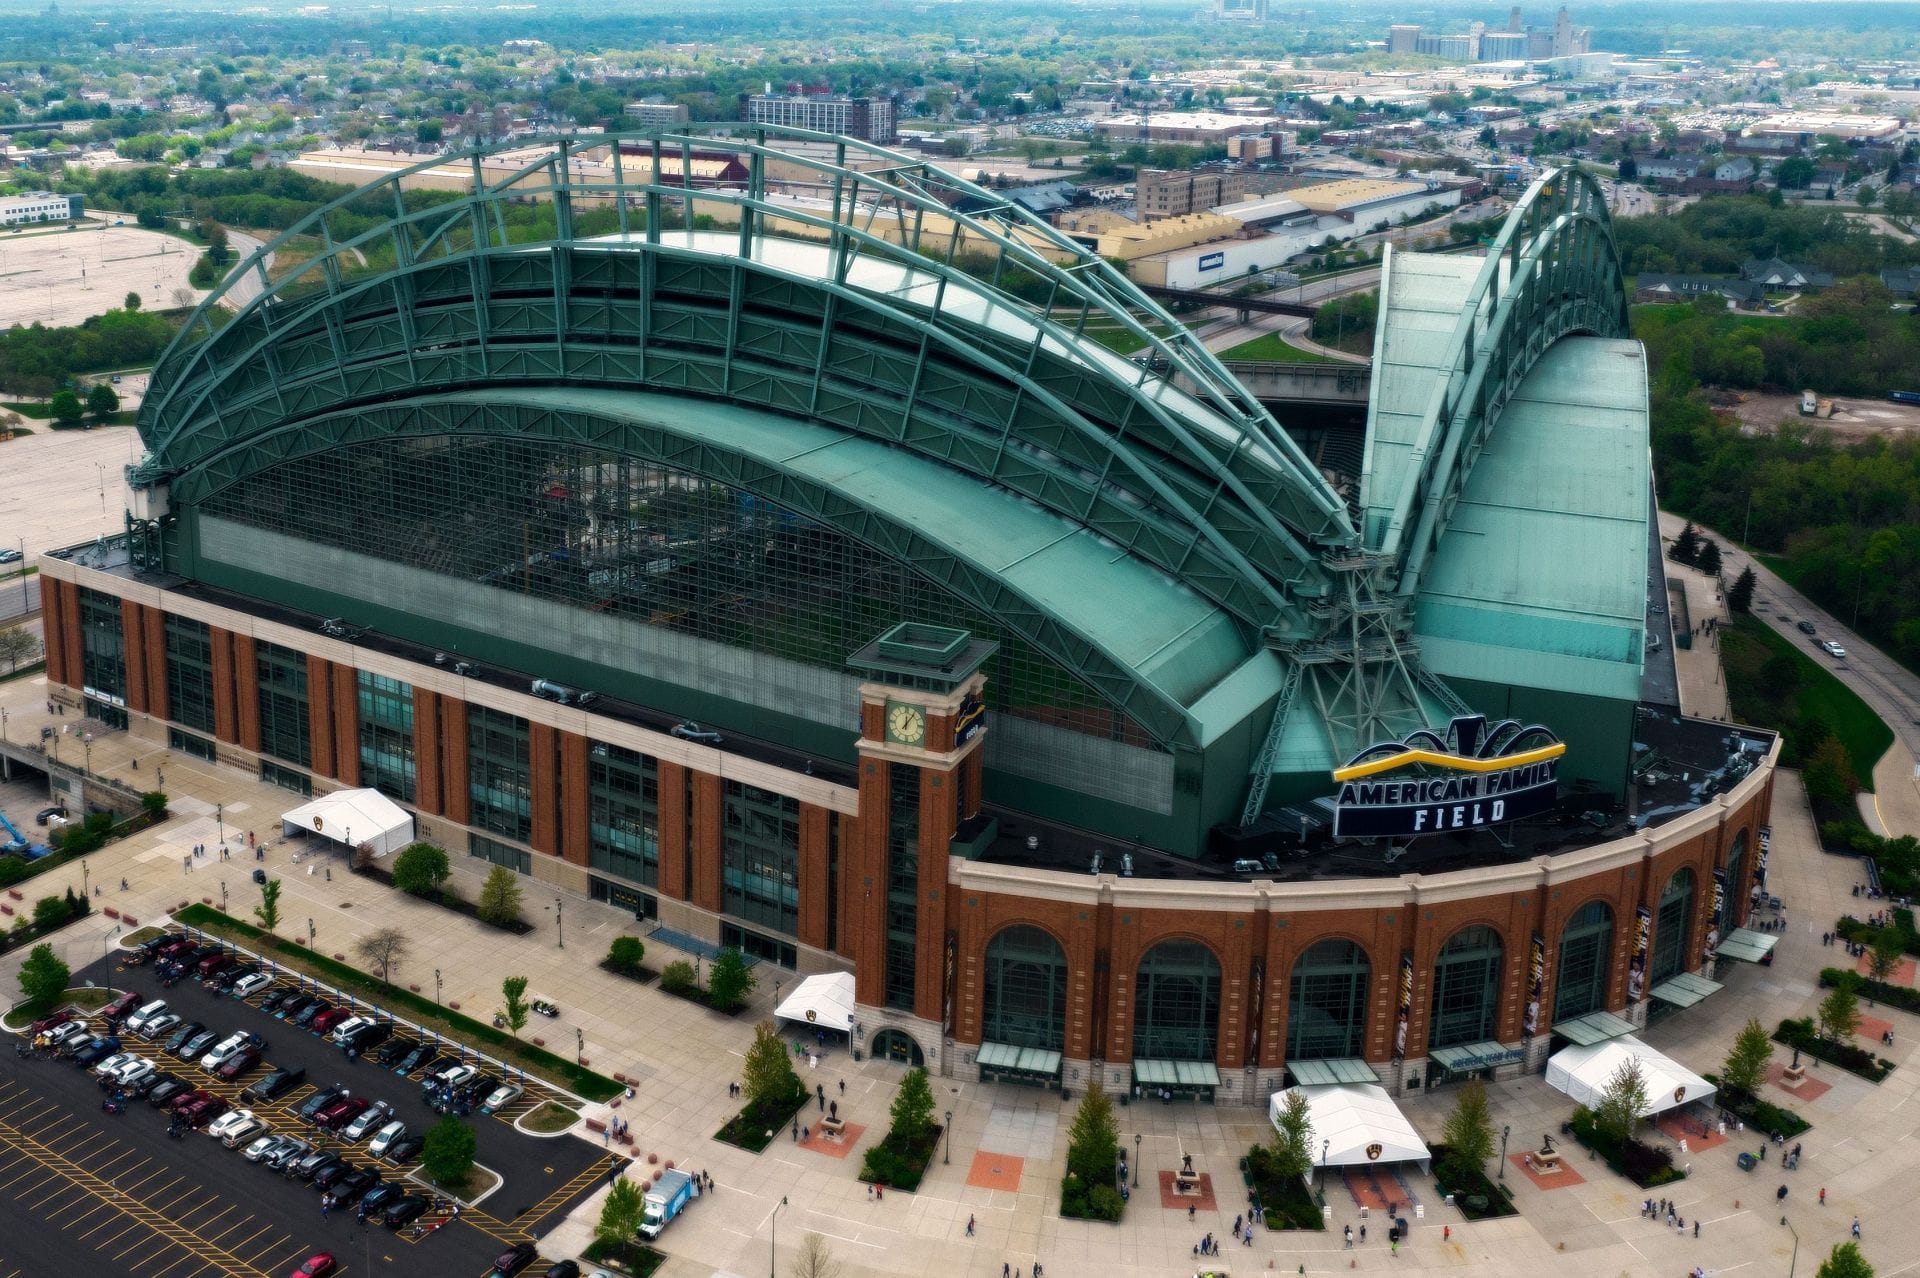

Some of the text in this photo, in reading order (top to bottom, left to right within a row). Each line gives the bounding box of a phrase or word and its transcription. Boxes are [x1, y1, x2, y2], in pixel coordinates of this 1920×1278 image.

[1338, 758, 1559, 805] AMERICAN FAMILY
[1414, 800, 1505, 831] FIELD
